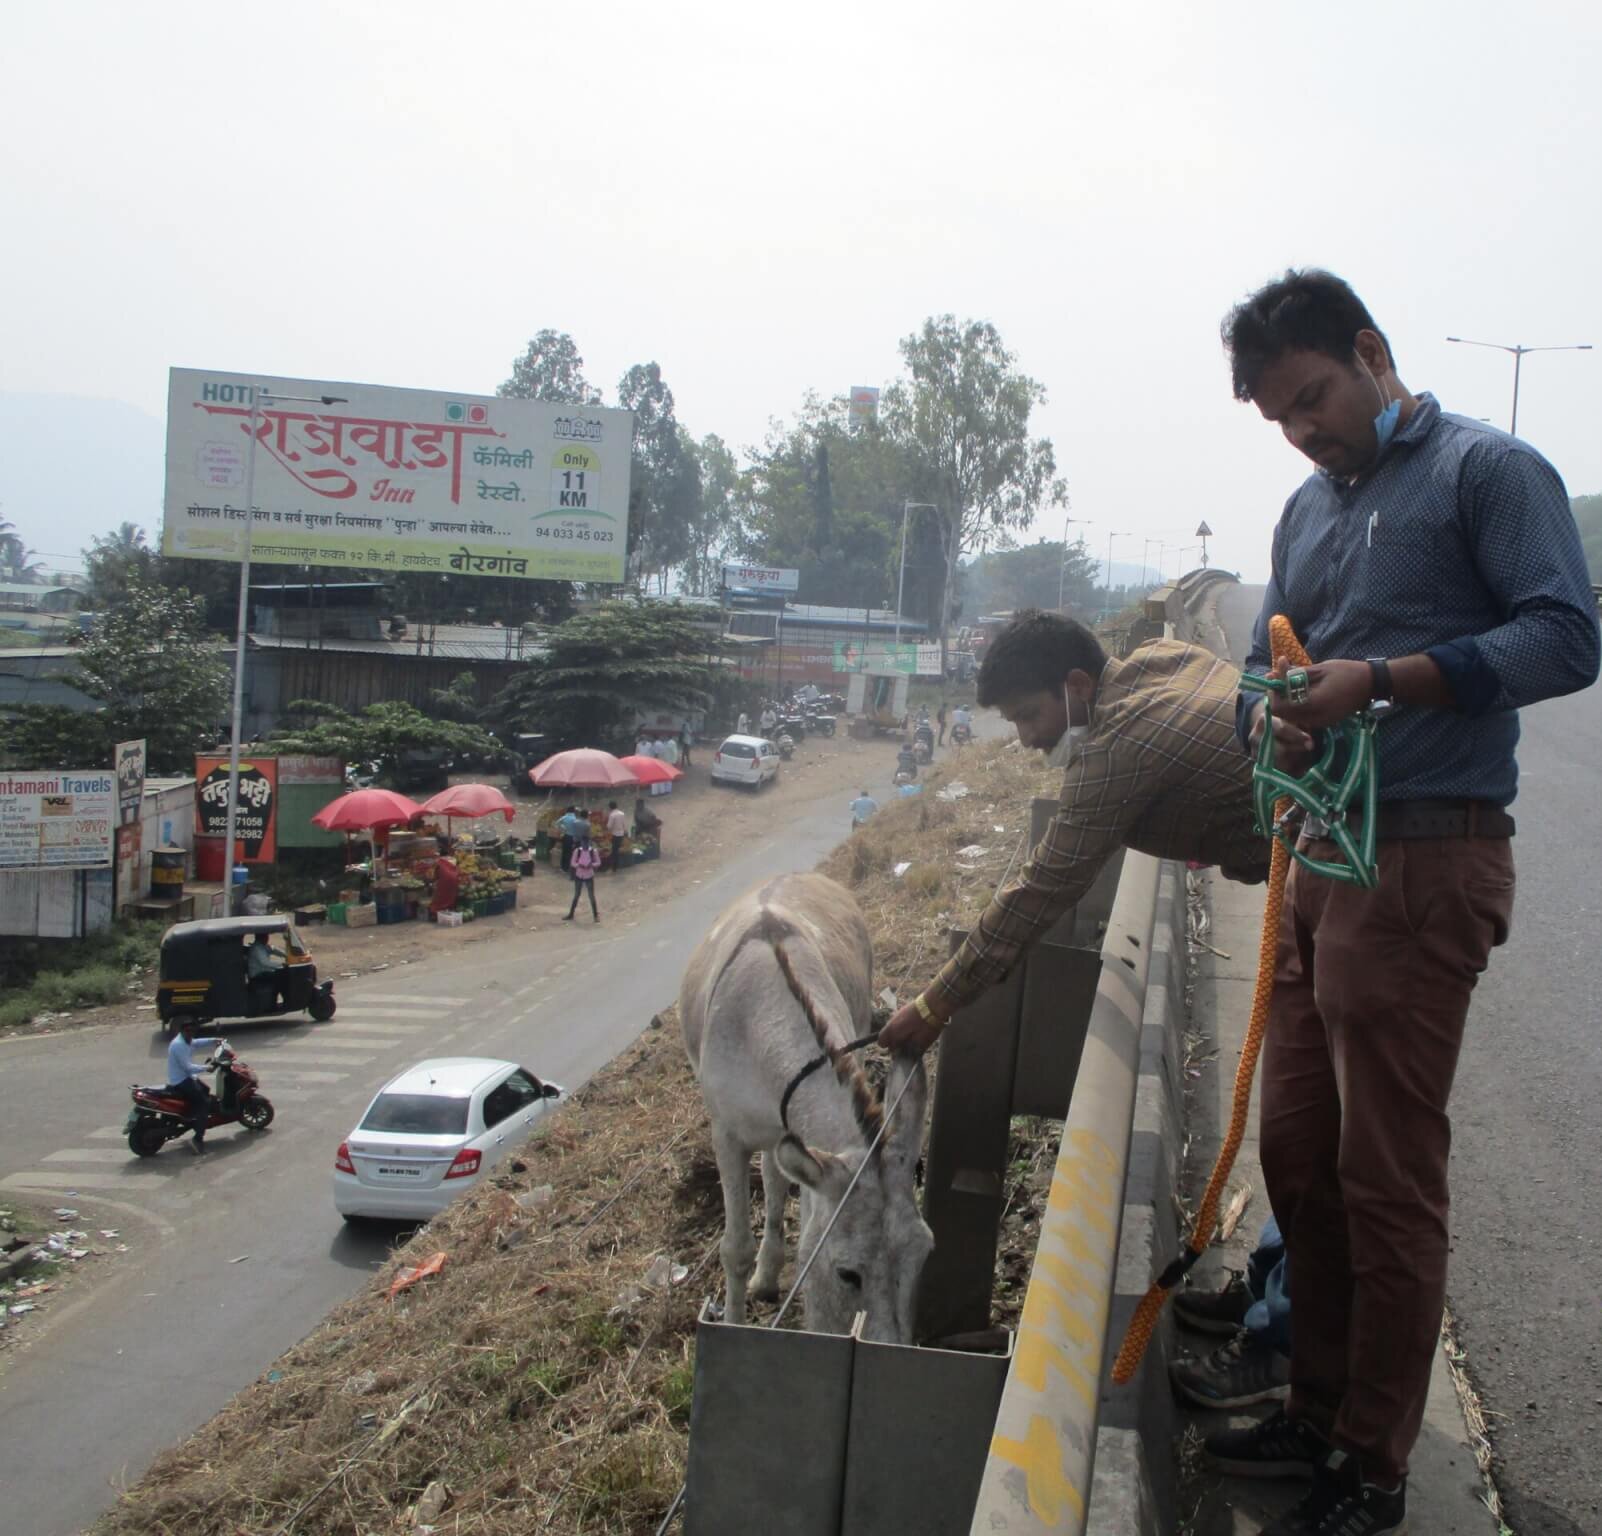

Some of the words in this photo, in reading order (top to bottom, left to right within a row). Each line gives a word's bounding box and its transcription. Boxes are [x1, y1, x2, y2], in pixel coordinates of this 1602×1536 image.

[193, 402, 507, 505] राजवाडा
[473, 446, 534, 470] फॅमिली
[563, 453, 589, 468] Only
[370, 479, 416, 503] Inn
[562, 471, 585, 490] 11
[560, 490, 587, 508] KM
[186, 502, 220, 519] सोशल
[273, 511, 281, 522] व
[284, 508, 302, 523] सर्व
[304, 513, 332, 529] सुरक्षा
[335, 511, 382, 529] नियमांसह
[428, 520, 467, 534] आपल्या
[536, 527, 550, 538] 94
[553, 528, 574, 540] 033
[576, 530, 591, 541] 45
[593, 531, 614, 542] 023
[449, 546, 529, 576] बोरगांव
[62, 776, 112, 793] Travels
